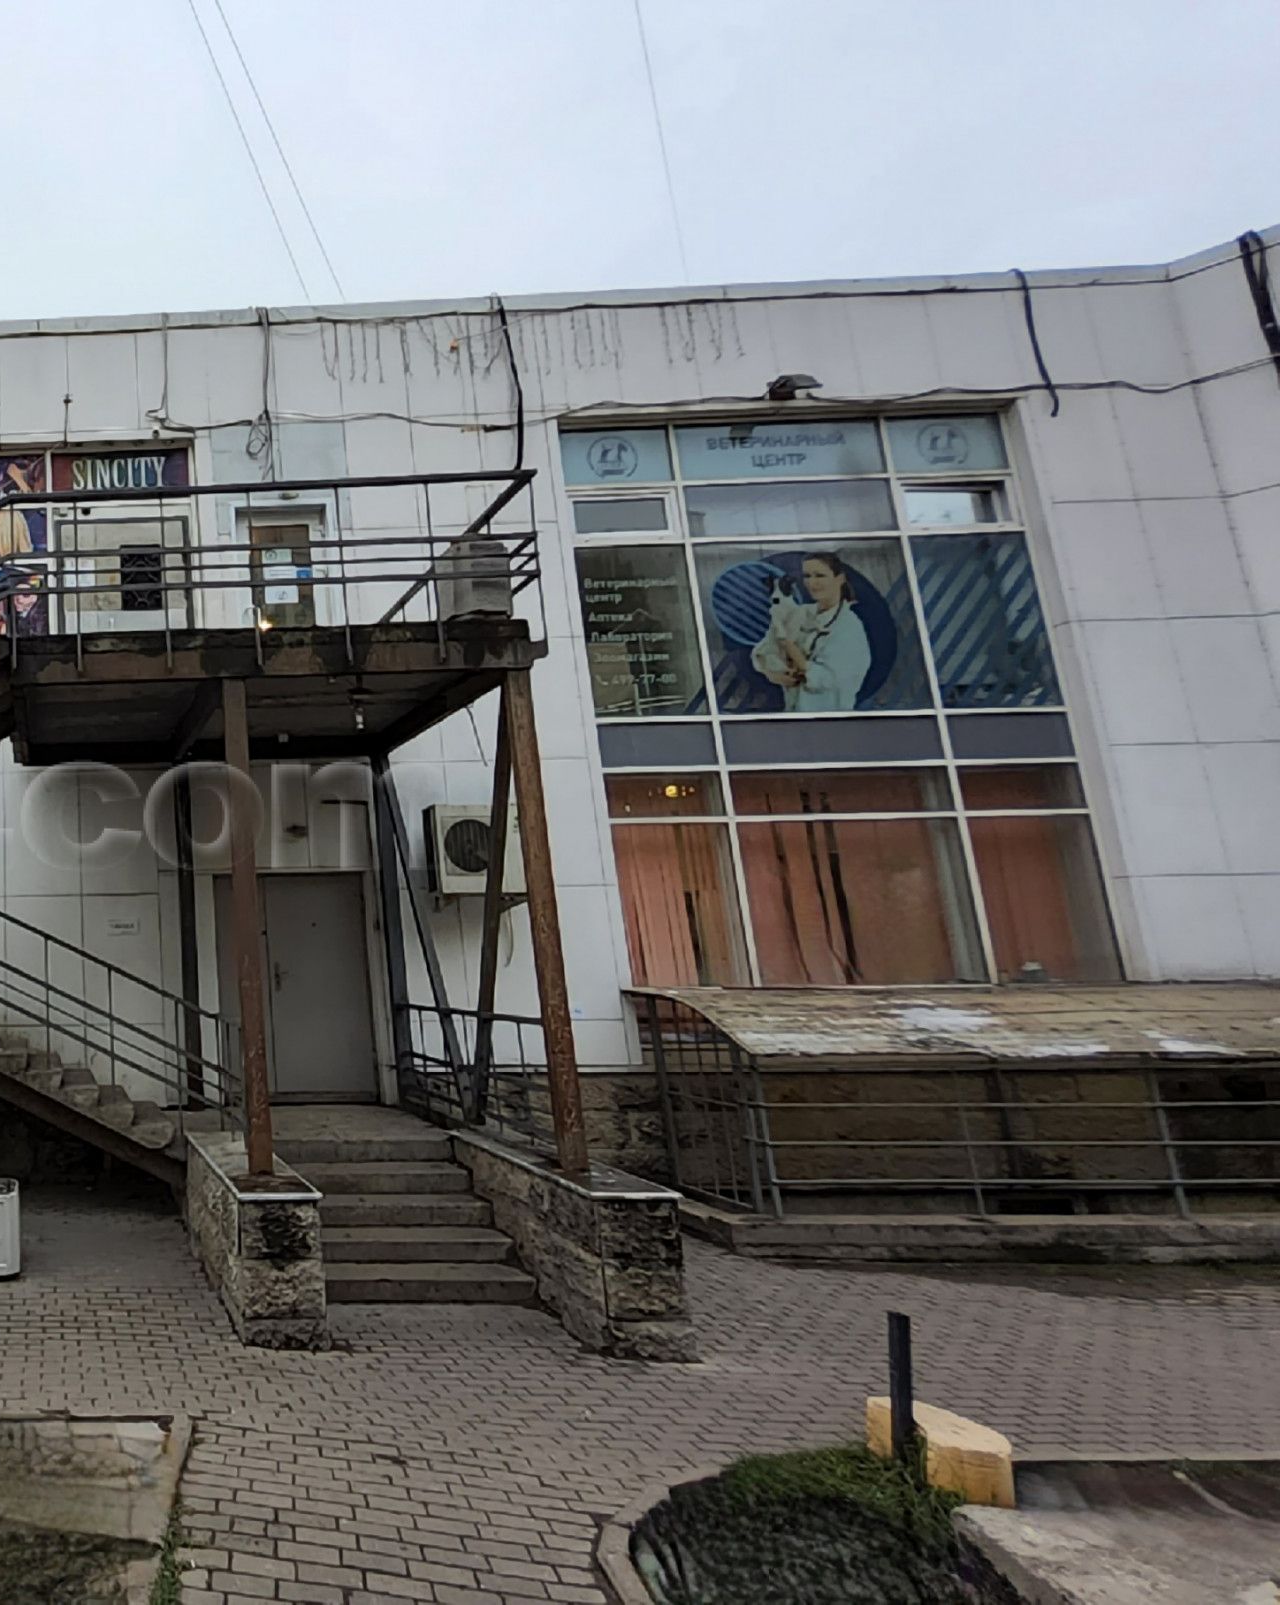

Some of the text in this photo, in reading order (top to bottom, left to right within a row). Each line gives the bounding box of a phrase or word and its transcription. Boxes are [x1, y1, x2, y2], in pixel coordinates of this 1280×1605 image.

[705, 430, 846, 450] ВЕТЕРИНАРНЫЙ
[751, 453, 807, 469] ЦЕНТР
[71, 456, 166, 490] SINCITY
[585, 593, 623, 604] центр
[588, 611, 633, 622] Аптека
